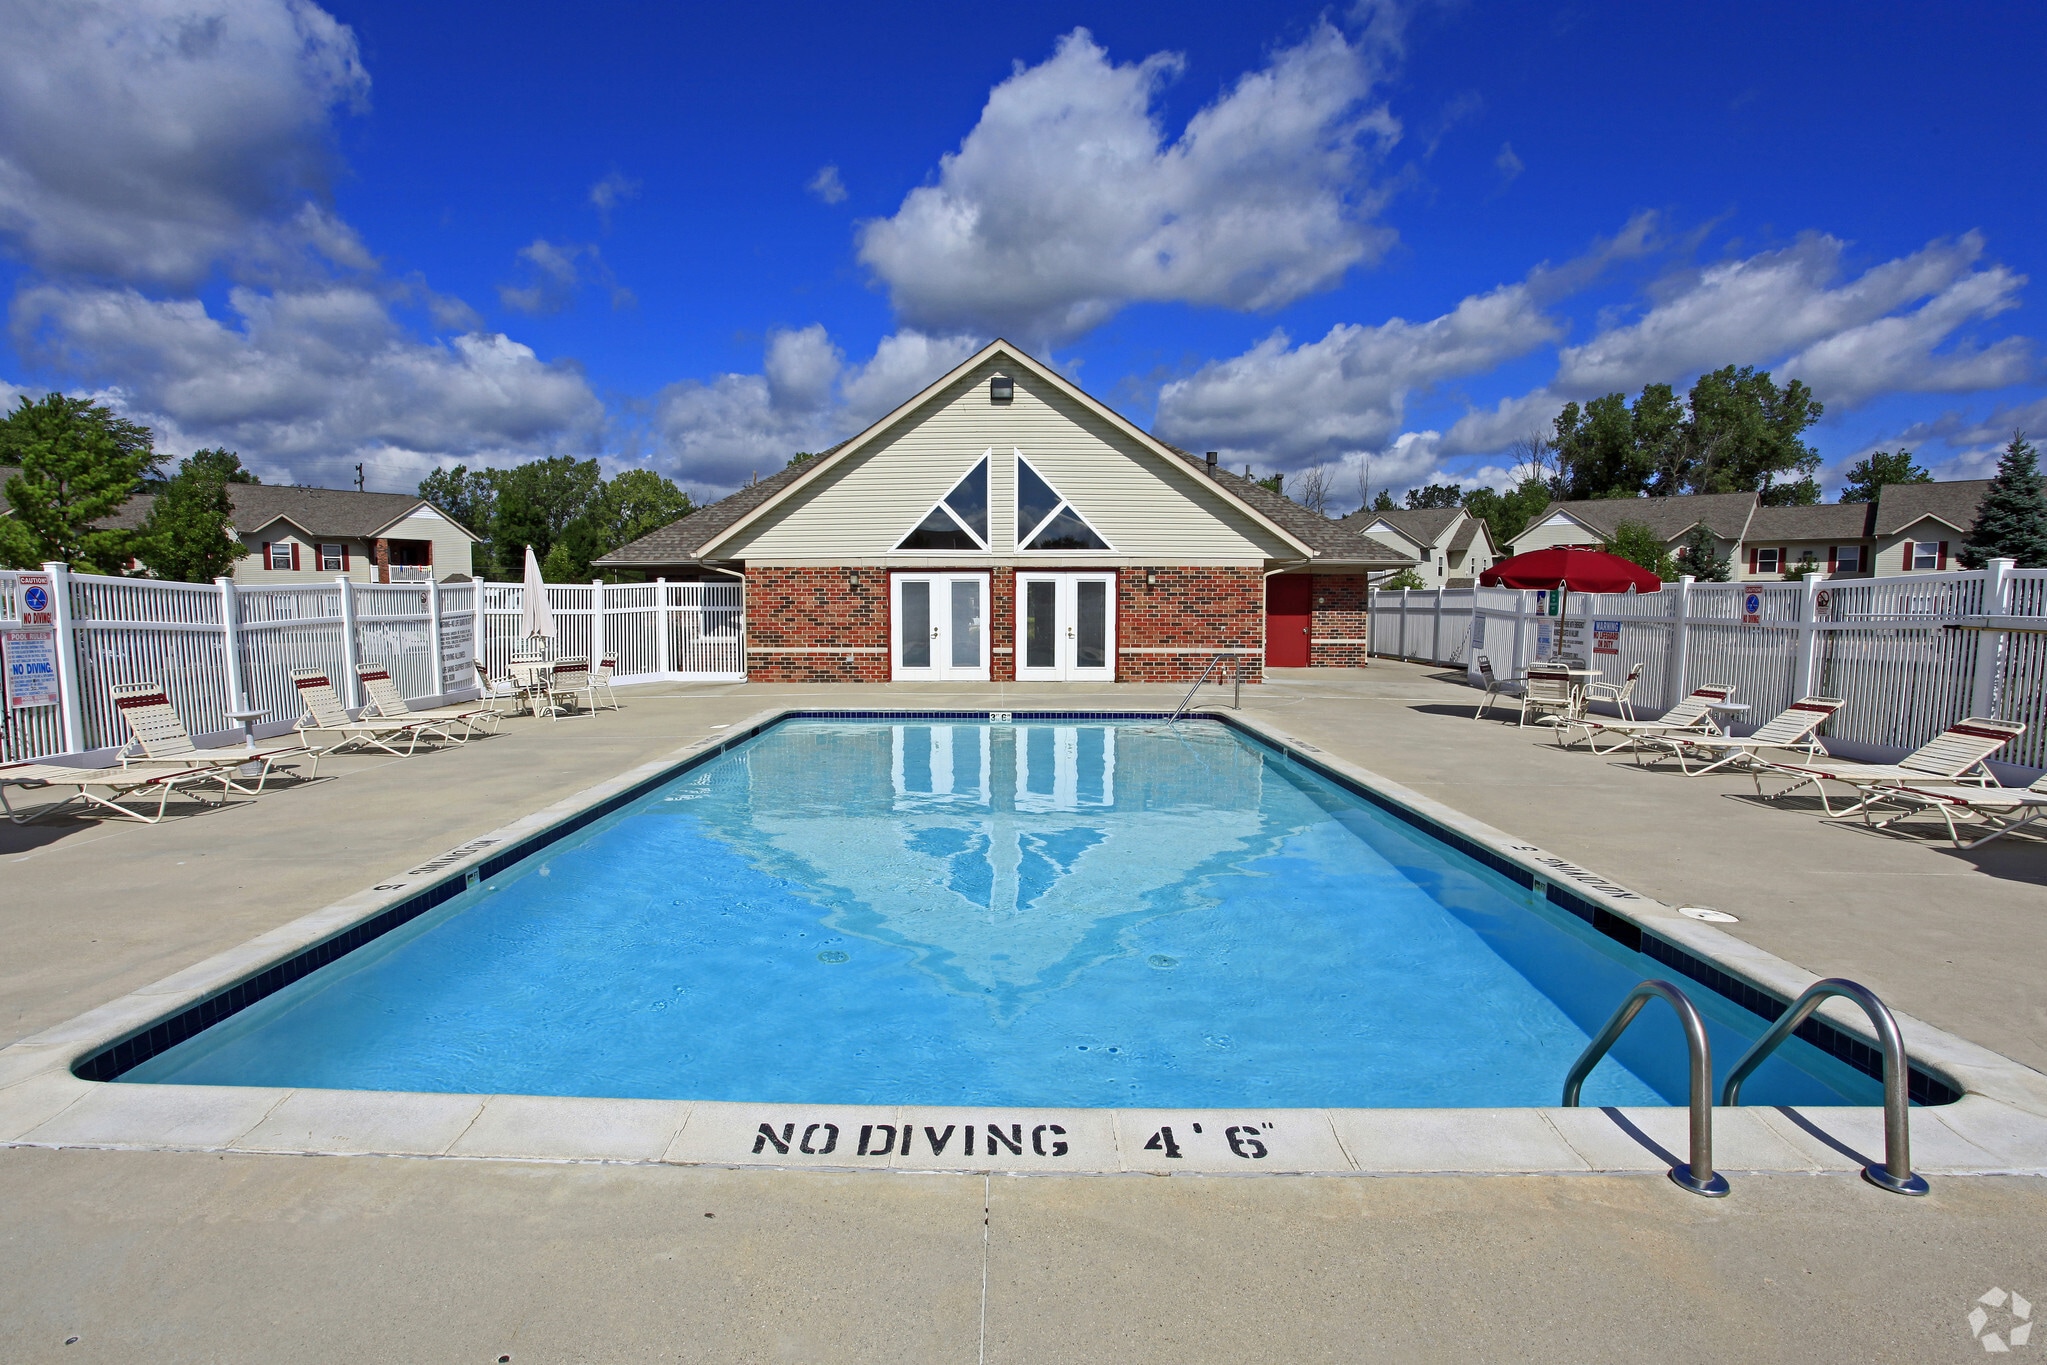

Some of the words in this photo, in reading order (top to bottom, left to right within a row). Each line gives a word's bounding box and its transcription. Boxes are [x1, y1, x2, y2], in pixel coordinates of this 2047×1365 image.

[24, 612, 31, 624] NO
[34, 612, 52, 624] DIVING!
[1597, 622, 1619, 631] WARNING
[1600, 632, 1619, 640] LIFEGUARD
[1604, 640, 1613, 648] DUTY
[12, 663, 24, 675] NO
[751, 1122, 839, 1156] NO
[856, 1123, 1069, 1158] DIVING
